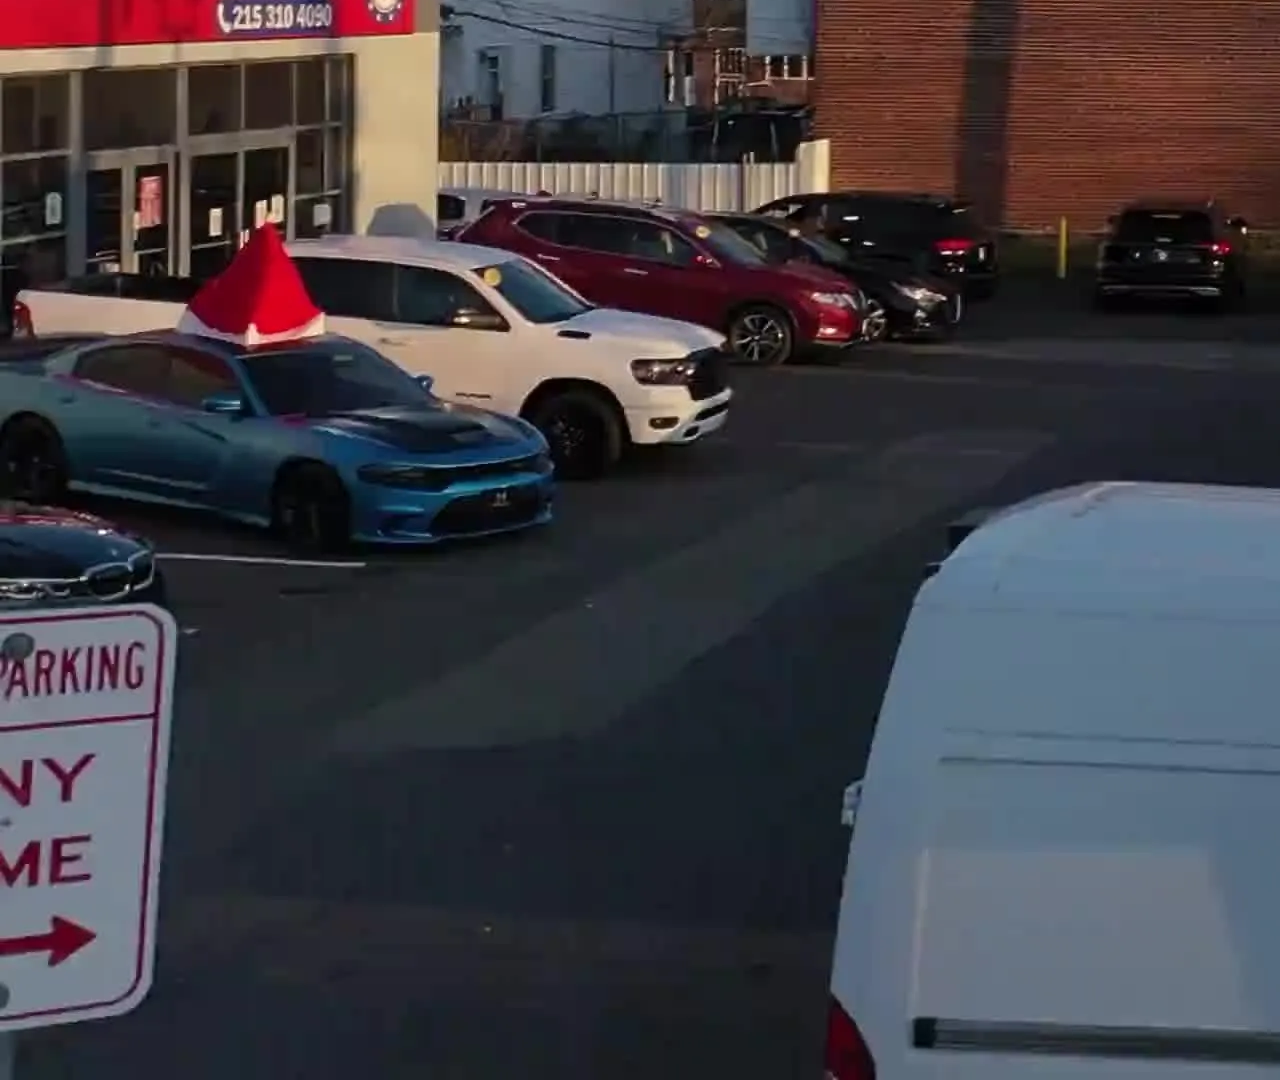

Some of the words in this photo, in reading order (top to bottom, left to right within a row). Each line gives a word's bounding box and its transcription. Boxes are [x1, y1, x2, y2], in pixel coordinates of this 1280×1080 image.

[232, 4, 262, 30] 215
[265, 3, 294, 29] 310
[296, 3, 332, 28] 4090
